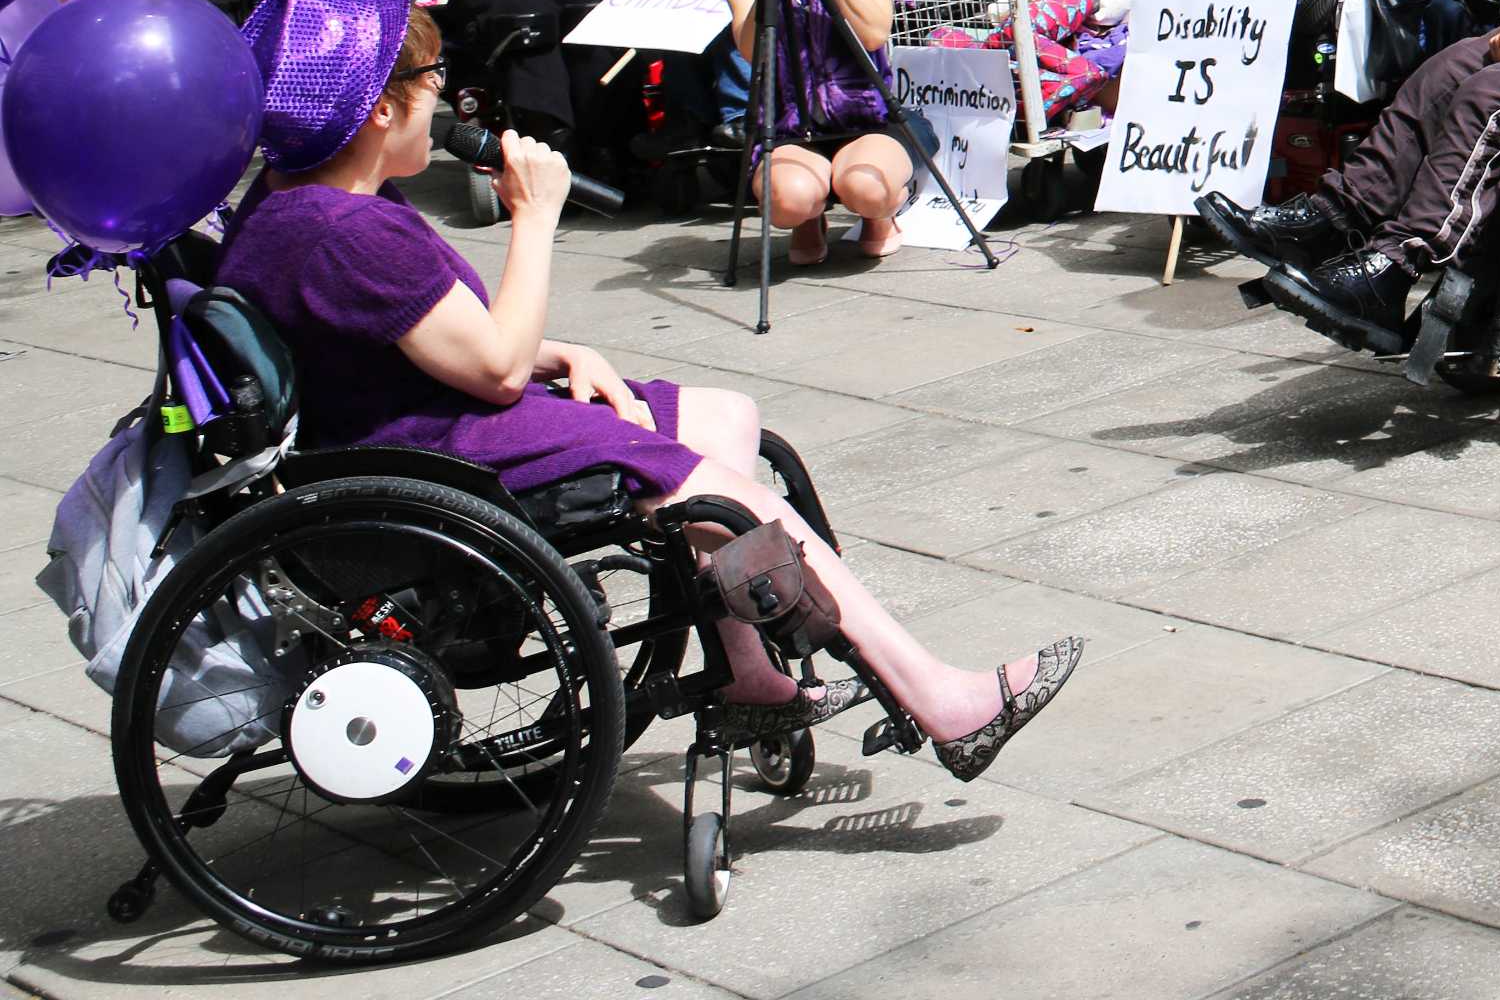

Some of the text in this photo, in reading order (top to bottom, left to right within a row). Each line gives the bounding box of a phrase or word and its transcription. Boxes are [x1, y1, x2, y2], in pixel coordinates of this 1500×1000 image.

[1157, 4, 1268, 65] Disability
[897, 68, 1011, 113] Discrimination
[1168, 58, 1217, 105] IS
[951, 136, 968, 169] my
[1119, 120, 1258, 192] Beautiful
